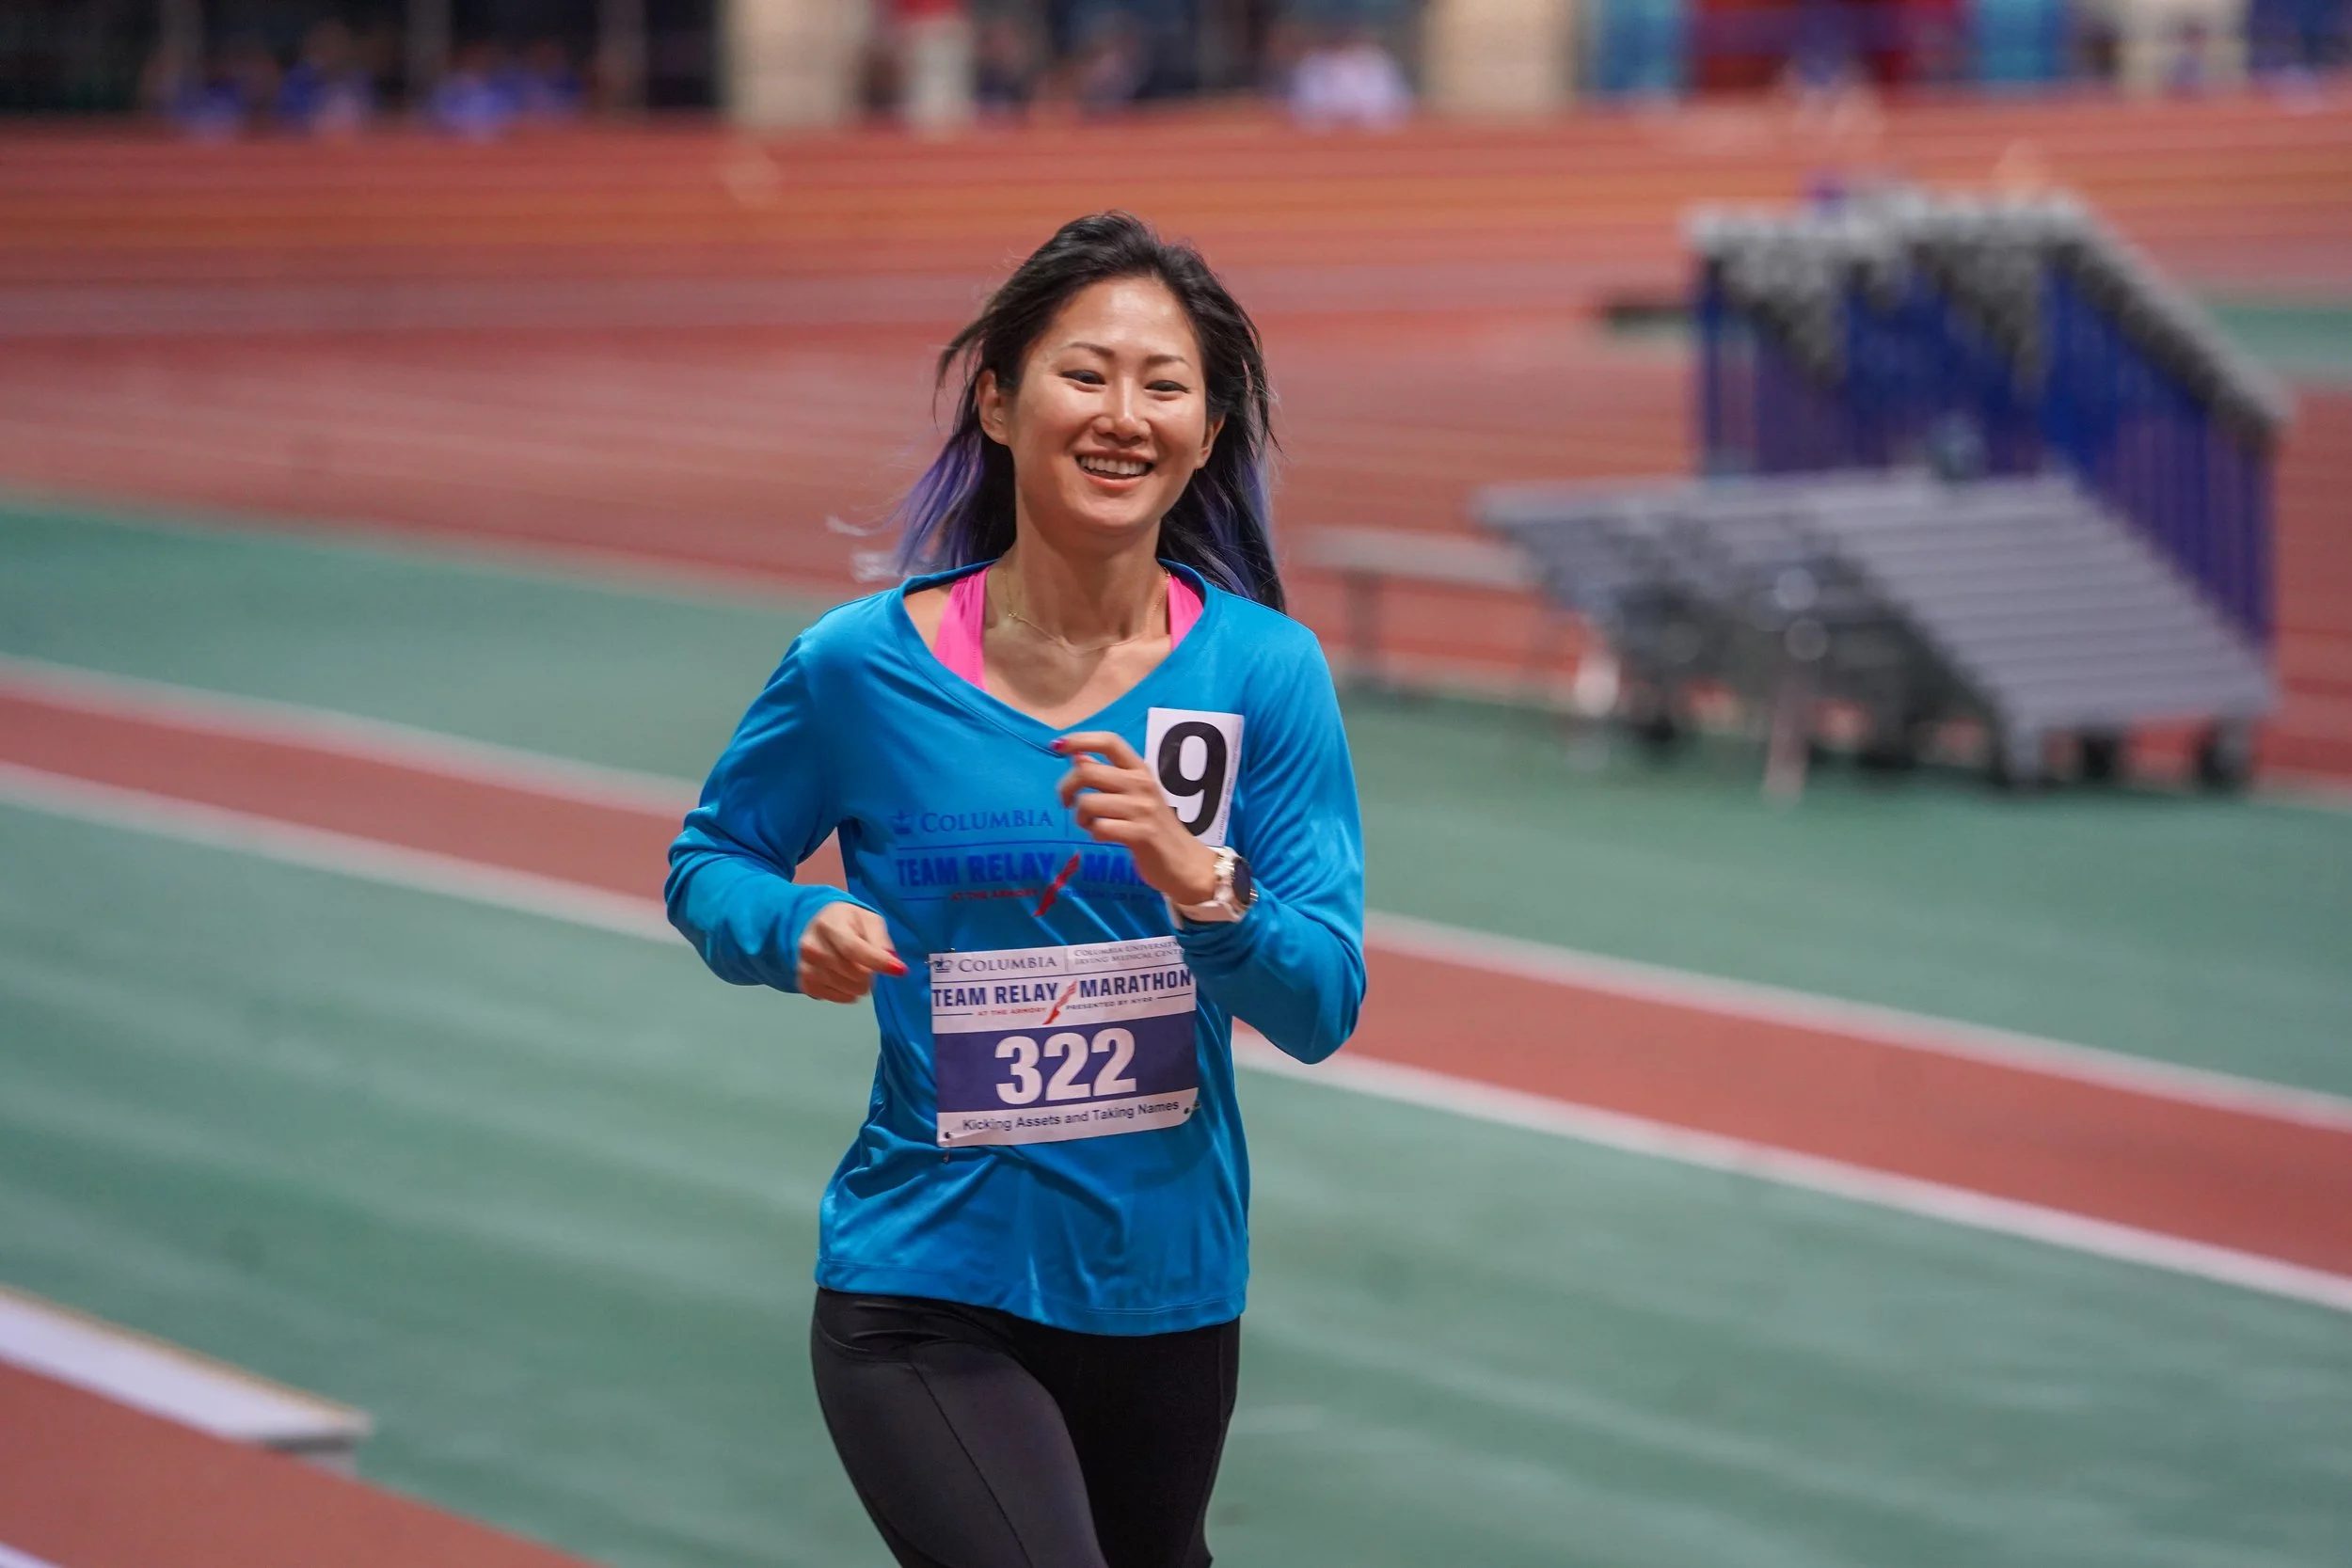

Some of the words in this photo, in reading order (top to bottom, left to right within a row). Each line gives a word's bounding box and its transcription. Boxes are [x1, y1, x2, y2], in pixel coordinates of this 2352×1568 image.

[1157, 721, 1228, 837] 9
[920, 809, 1055, 833] COLUMBIA
[896, 857, 958, 887] TEAM
[966, 852, 1056, 883] RELAY
[958, 957, 1057, 973] COLUMBIA
[932, 987, 986, 1006] TEAM
[994, 982, 1058, 1005] RELAY
[1079, 968, 1192, 998] MARATHON
[1065, 1000, 1116, 1010] PRESENTED
[993, 1027, 1137, 1105] 322
[962, 1117, 1012, 1132] Kicking
[1015, 1115, 1061, 1129] Assets
[1064, 1110, 1089, 1125] and
[1092, 1106, 1136, 1120] Taking
[1136, 1101, 1181, 1115] Names
